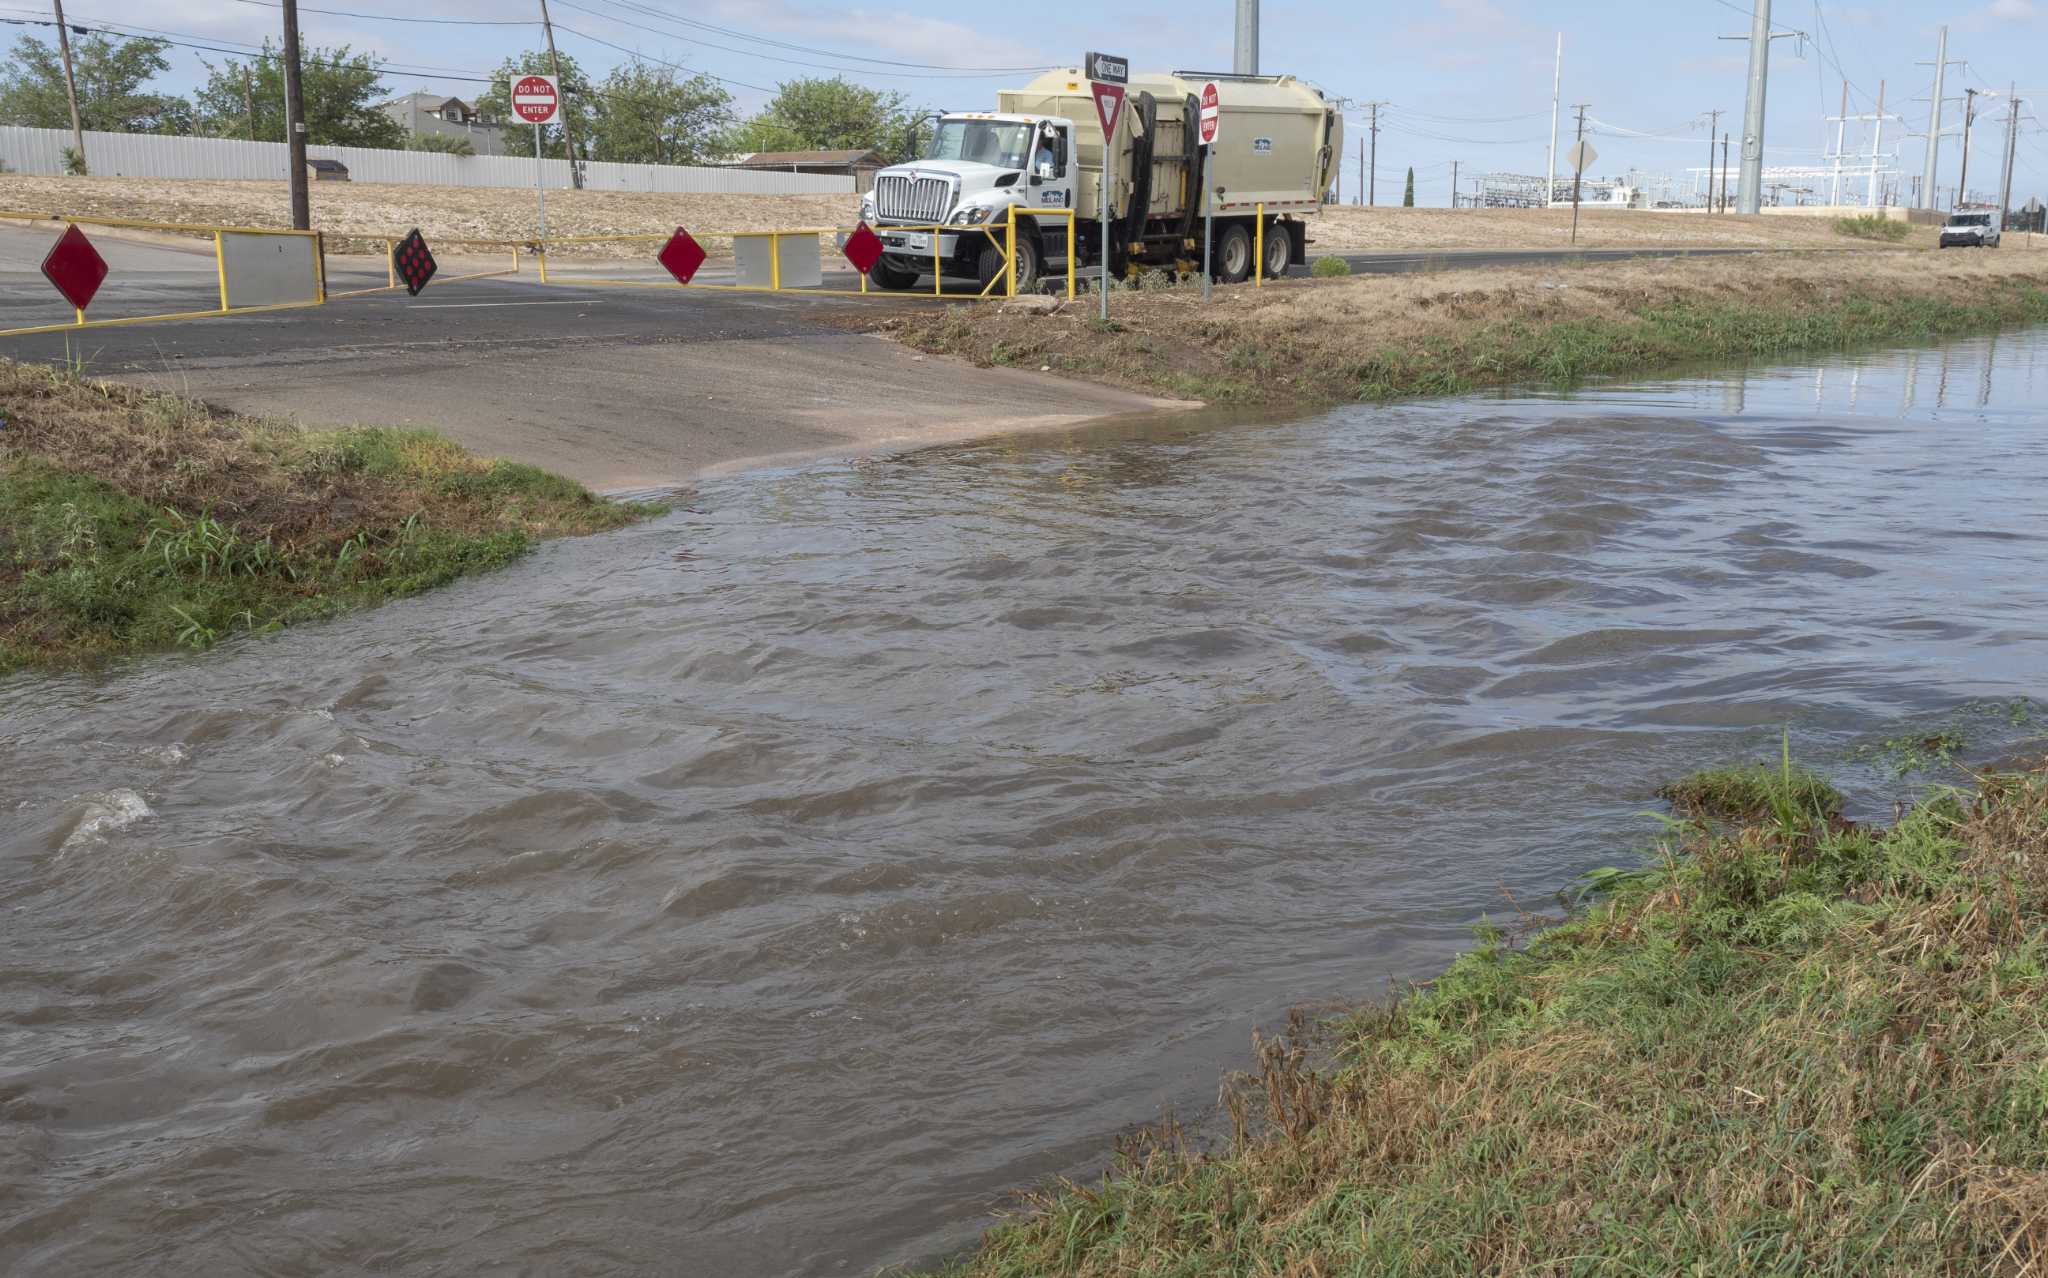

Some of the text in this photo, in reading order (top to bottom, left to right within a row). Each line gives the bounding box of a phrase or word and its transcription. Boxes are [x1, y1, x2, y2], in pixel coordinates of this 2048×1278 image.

[1102, 62, 1124, 74] ONE WAY
[518, 85, 551, 94] DO NOT
[522, 105, 549, 114] ENTER
[1203, 120, 1215, 131] ENTER
